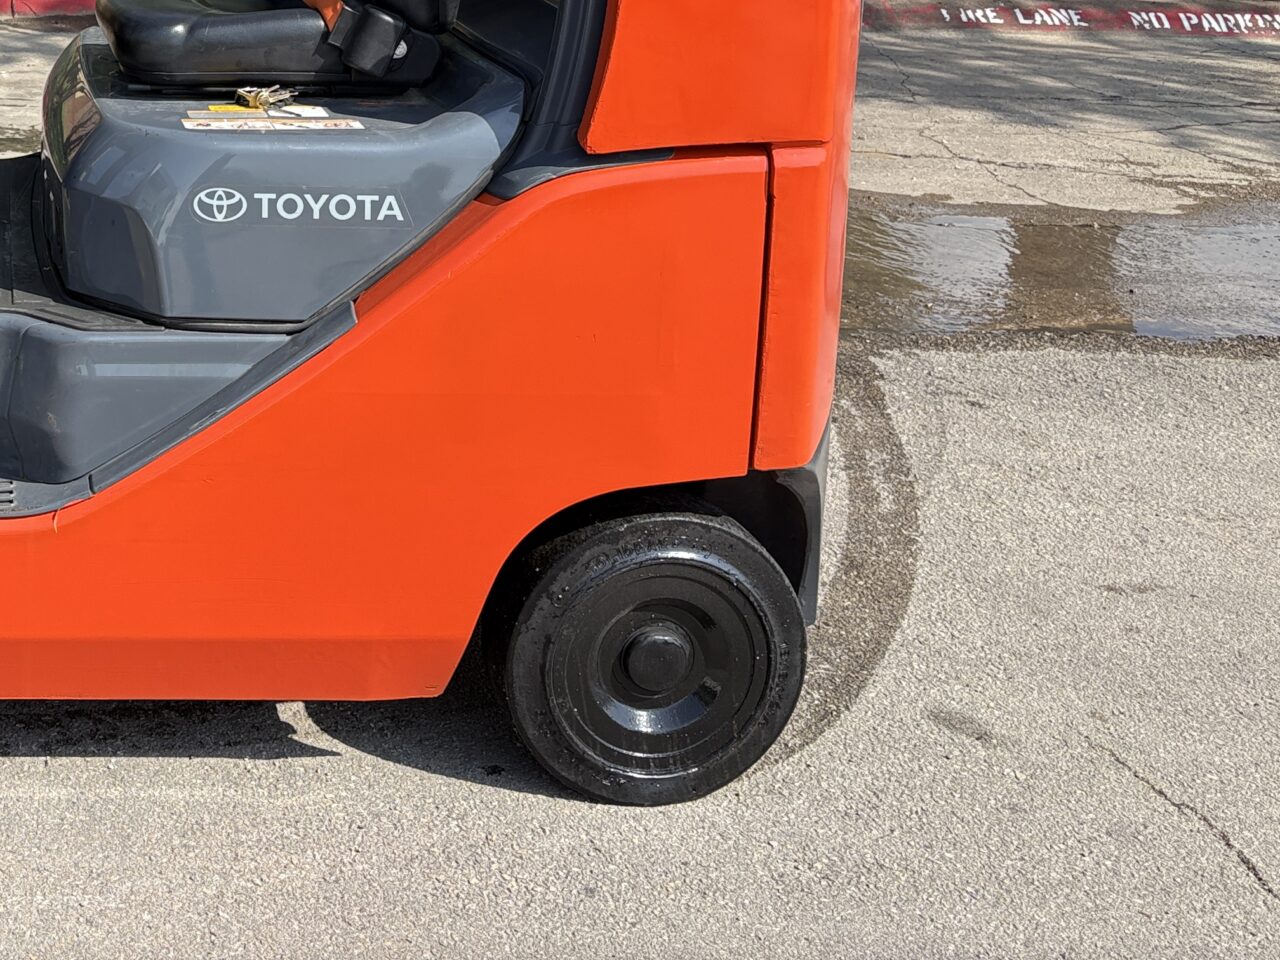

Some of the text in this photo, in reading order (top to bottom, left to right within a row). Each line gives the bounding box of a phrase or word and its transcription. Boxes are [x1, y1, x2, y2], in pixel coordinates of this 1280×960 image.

[1014, 8, 1089, 27] LANE
[1128, 11, 1171, 29] NO
[253, 193, 404, 221] TOYOTA
